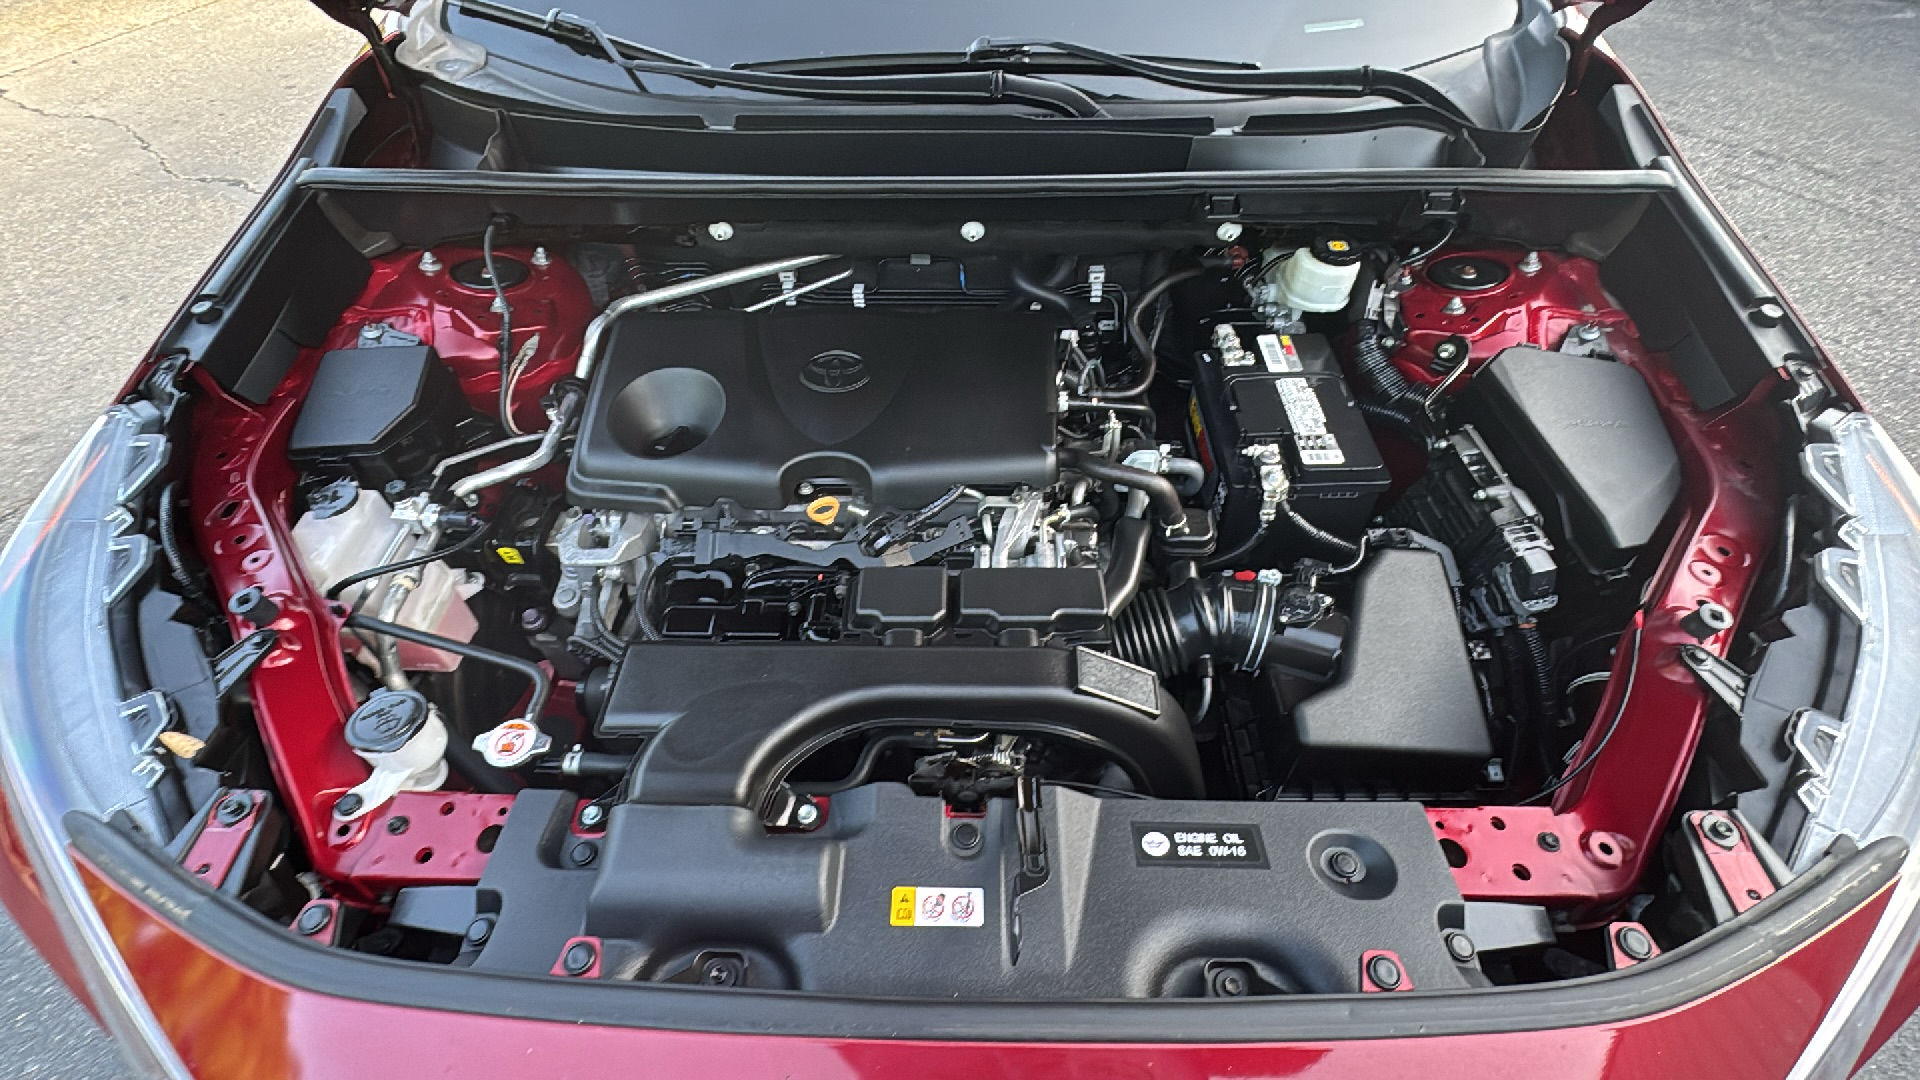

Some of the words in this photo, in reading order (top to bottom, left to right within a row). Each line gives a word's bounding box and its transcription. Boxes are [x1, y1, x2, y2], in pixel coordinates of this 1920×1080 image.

[1173, 832, 1218, 844] ENGINE
[1222, 833, 1245, 844] OIL
[1177, 845, 1203, 857] SAE
